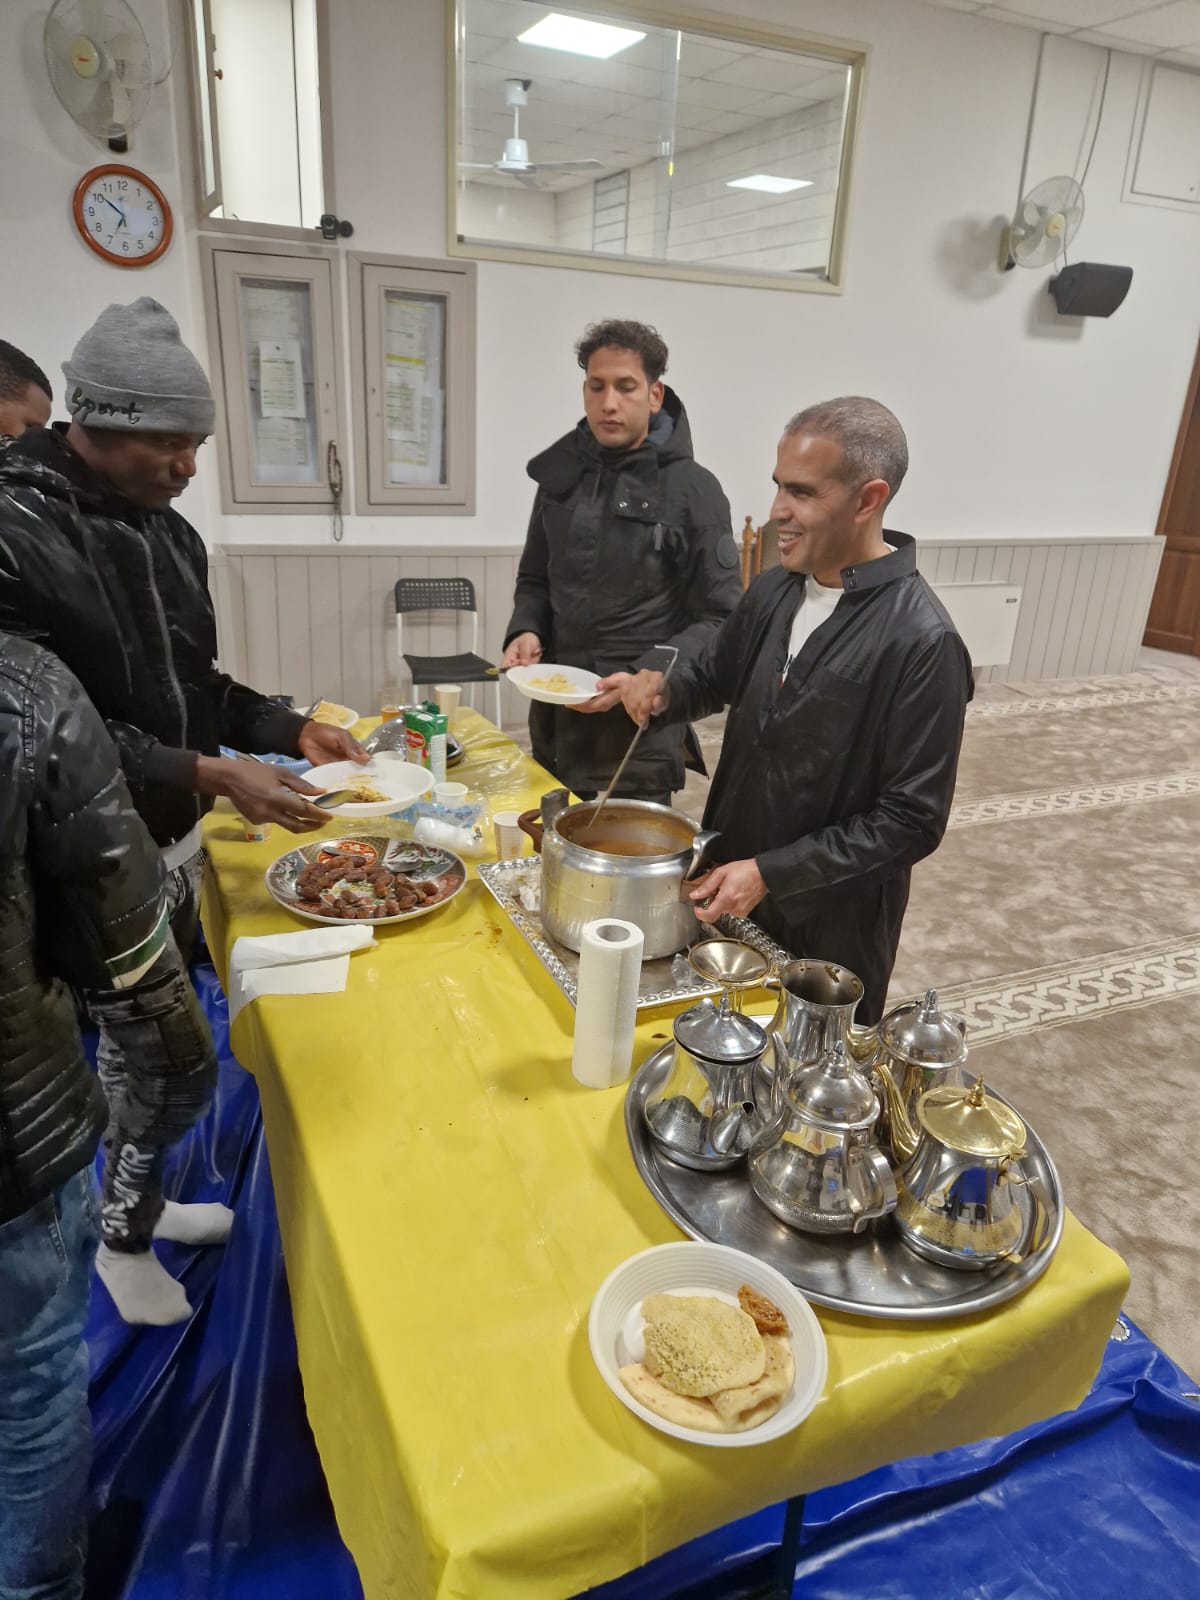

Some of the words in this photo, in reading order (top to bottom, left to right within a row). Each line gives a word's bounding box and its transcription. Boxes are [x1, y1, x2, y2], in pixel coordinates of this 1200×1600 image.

[102, 184, 113, 193] 11
[117, 181, 128, 190] 12
[136, 188, 141, 197] 1
[93, 193, 104, 203] 10
[146, 201, 153, 210] 2
[88, 207, 95, 216] 9
[152, 217, 159, 226] 3
[96, 222, 102, 232] 8
[107, 235, 114, 244] 7
[147, 231, 154, 239] 4
[122, 242, 129, 251] 6
[138, 240, 144, 249] 5
[72, 387, 143, 424] Sport
